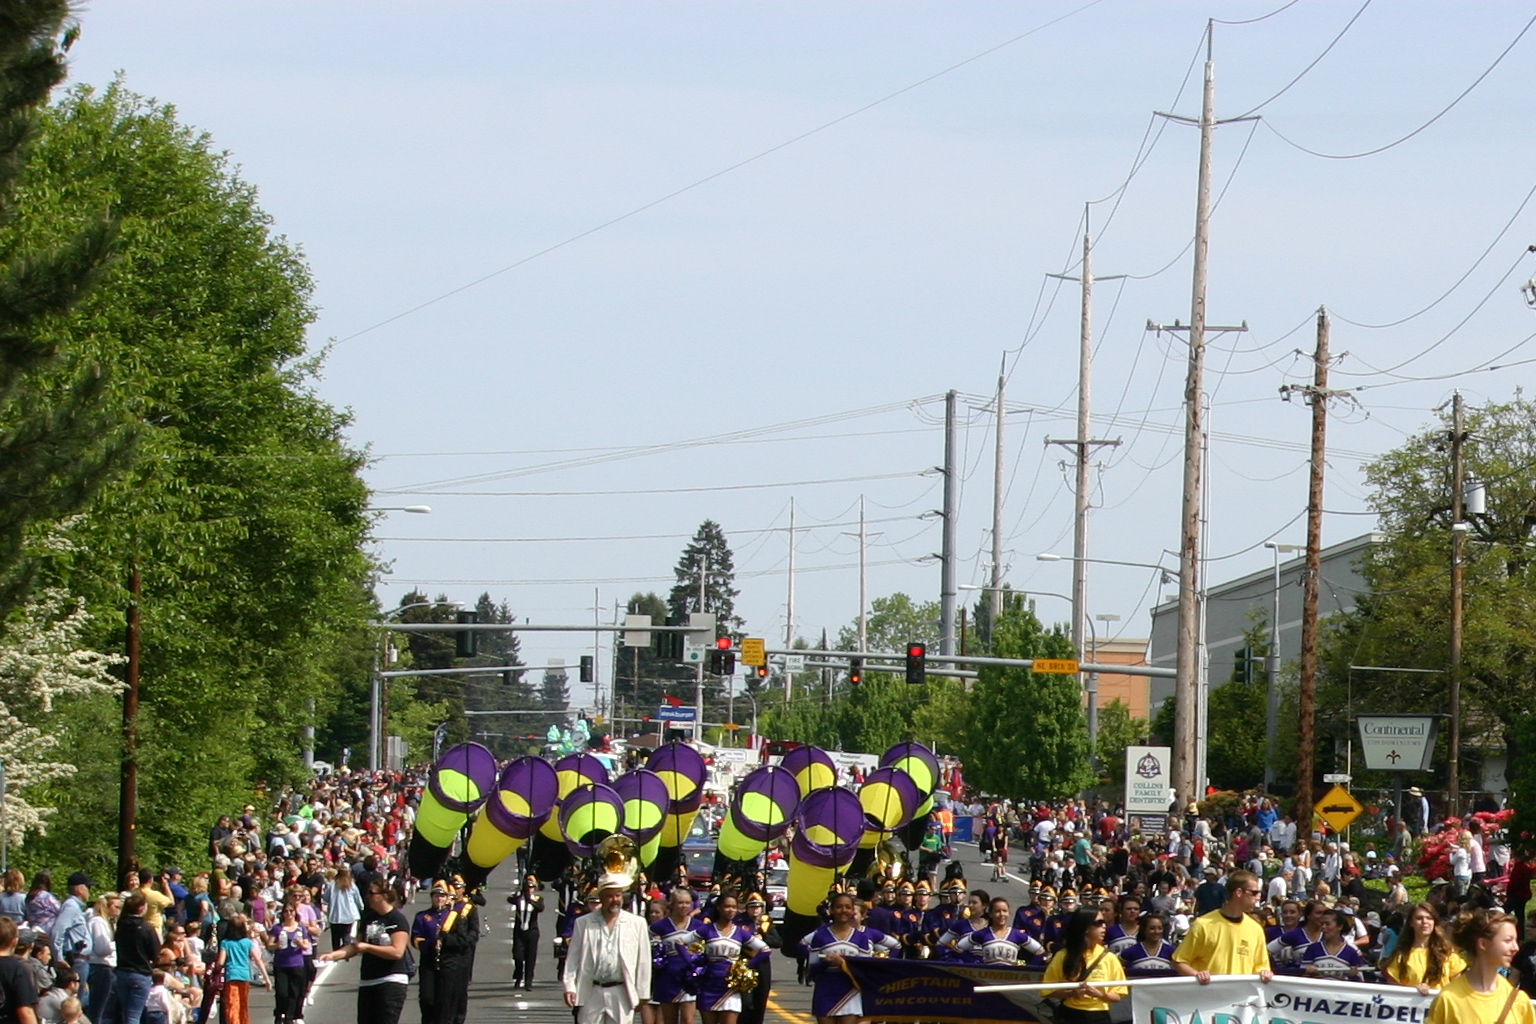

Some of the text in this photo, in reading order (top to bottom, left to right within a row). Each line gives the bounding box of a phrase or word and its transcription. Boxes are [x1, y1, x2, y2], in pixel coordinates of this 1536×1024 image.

[1364, 722, 1425, 735] Continental
[875, 996, 974, 1005] VANCOUVER
[1293, 996, 1372, 1018] HAZEL
